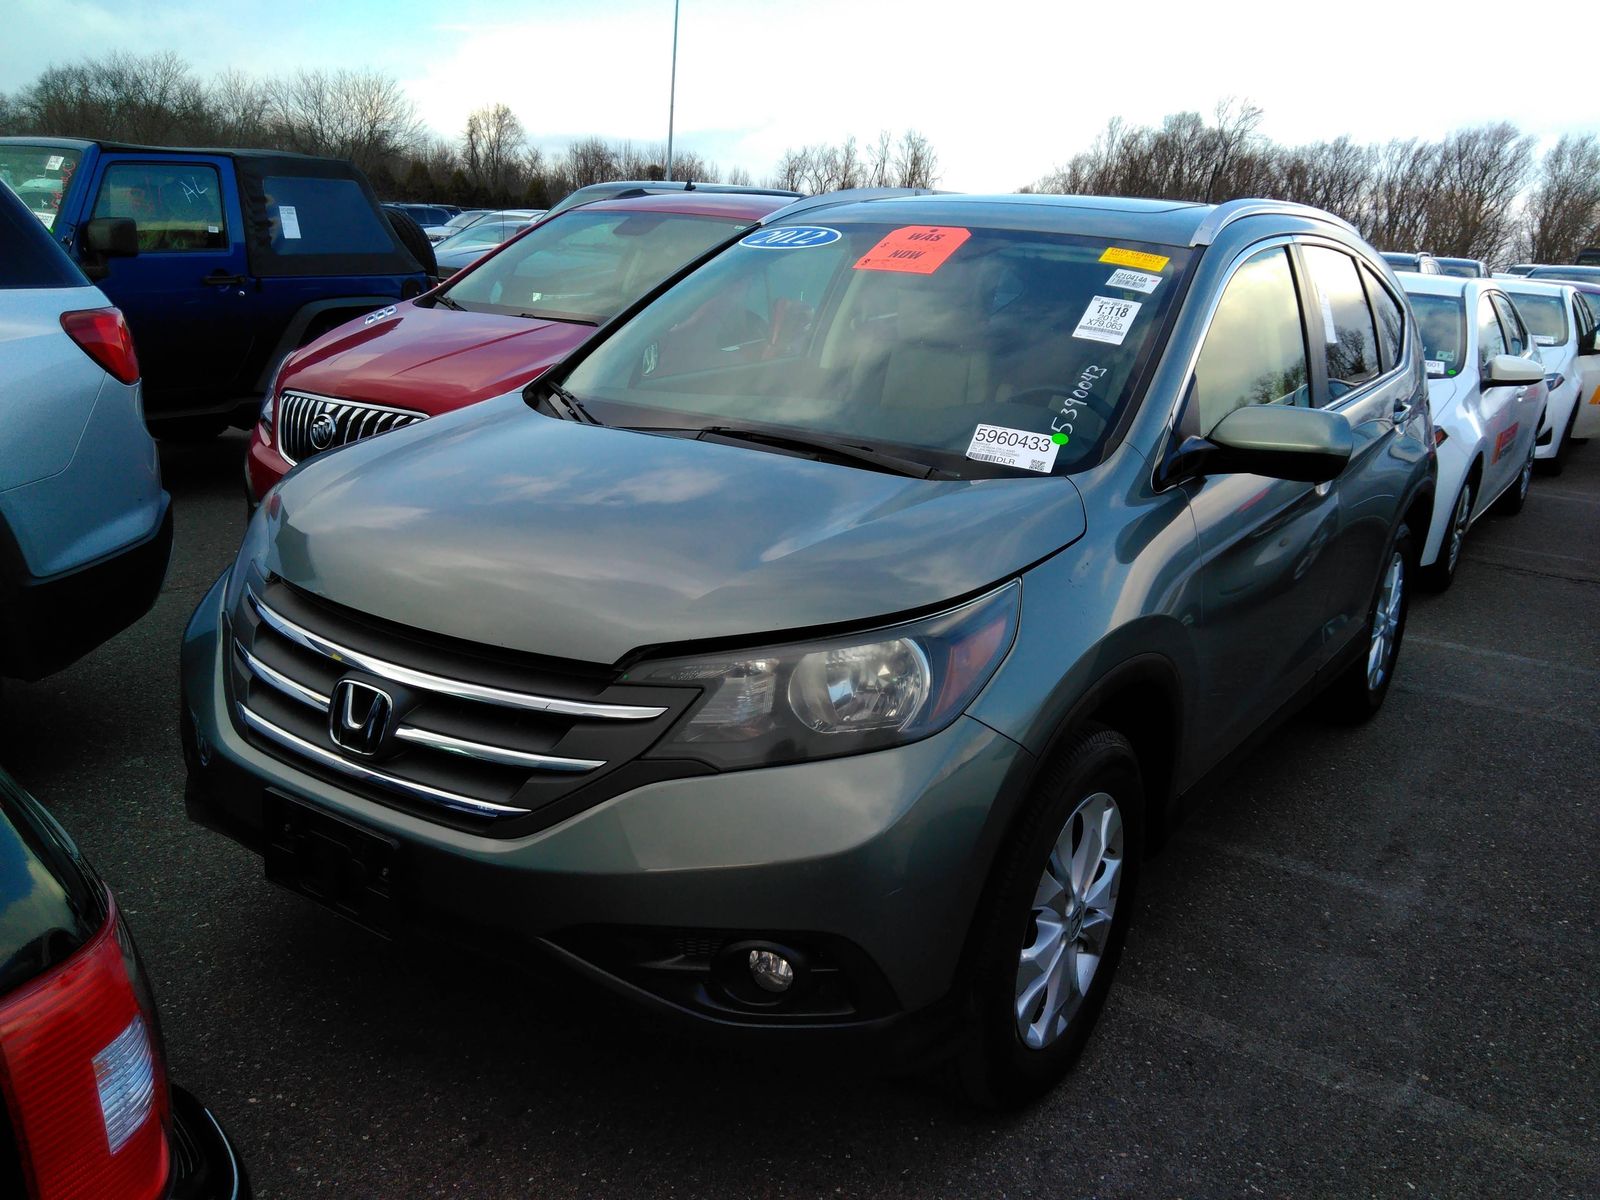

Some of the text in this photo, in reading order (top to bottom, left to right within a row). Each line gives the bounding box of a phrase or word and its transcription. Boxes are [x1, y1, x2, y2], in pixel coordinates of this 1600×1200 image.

[748, 230, 828, 244] 2012
[907, 232, 945, 242] WAS
[888, 249, 926, 260] NOW
[1097, 304, 1129, 317] 1:118
[975, 428, 1051, 452] 5960433
[996, 455, 1016, 465] DLR
